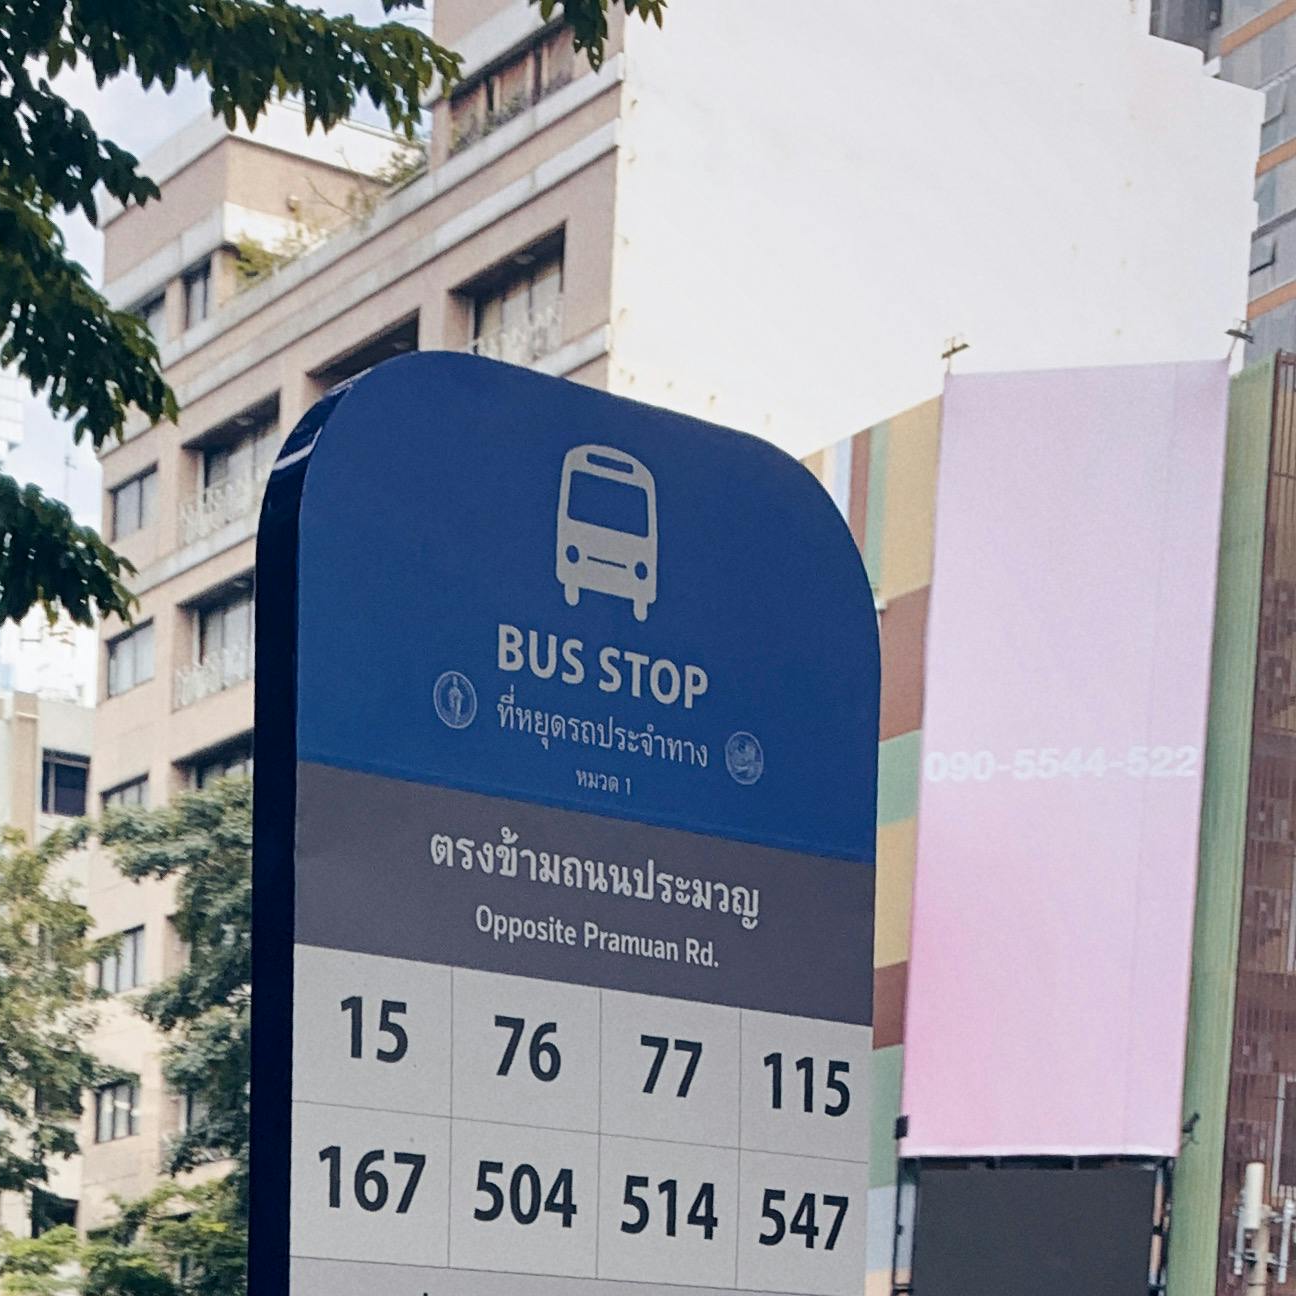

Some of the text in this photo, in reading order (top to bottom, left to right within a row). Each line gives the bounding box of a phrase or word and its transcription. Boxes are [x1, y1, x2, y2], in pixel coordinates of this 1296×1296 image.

[497, 623, 708, 709] BUS STOP
[497, 684, 708, 767] ที่หยุดรถประจำทาง
[575, 768, 632, 797] หมวด 1
[924, 745, 1199, 783] 090-5544-522
[430, 827, 760, 931] ตรงข้ามถนนประมวญ
[475, 904, 719, 968] Opposite Pramuan Rd.
[340, 995, 408, 1063] 15
[494, 1014, 562, 1082] 76
[640, 1034, 703, 1098] 77
[763, 1051, 850, 1118] 115
[318, 1144, 427, 1214] 167
[473, 1160, 578, 1229] 504
[620, 1174, 718, 1240] 514
[758, 1187, 849, 1251] 547
